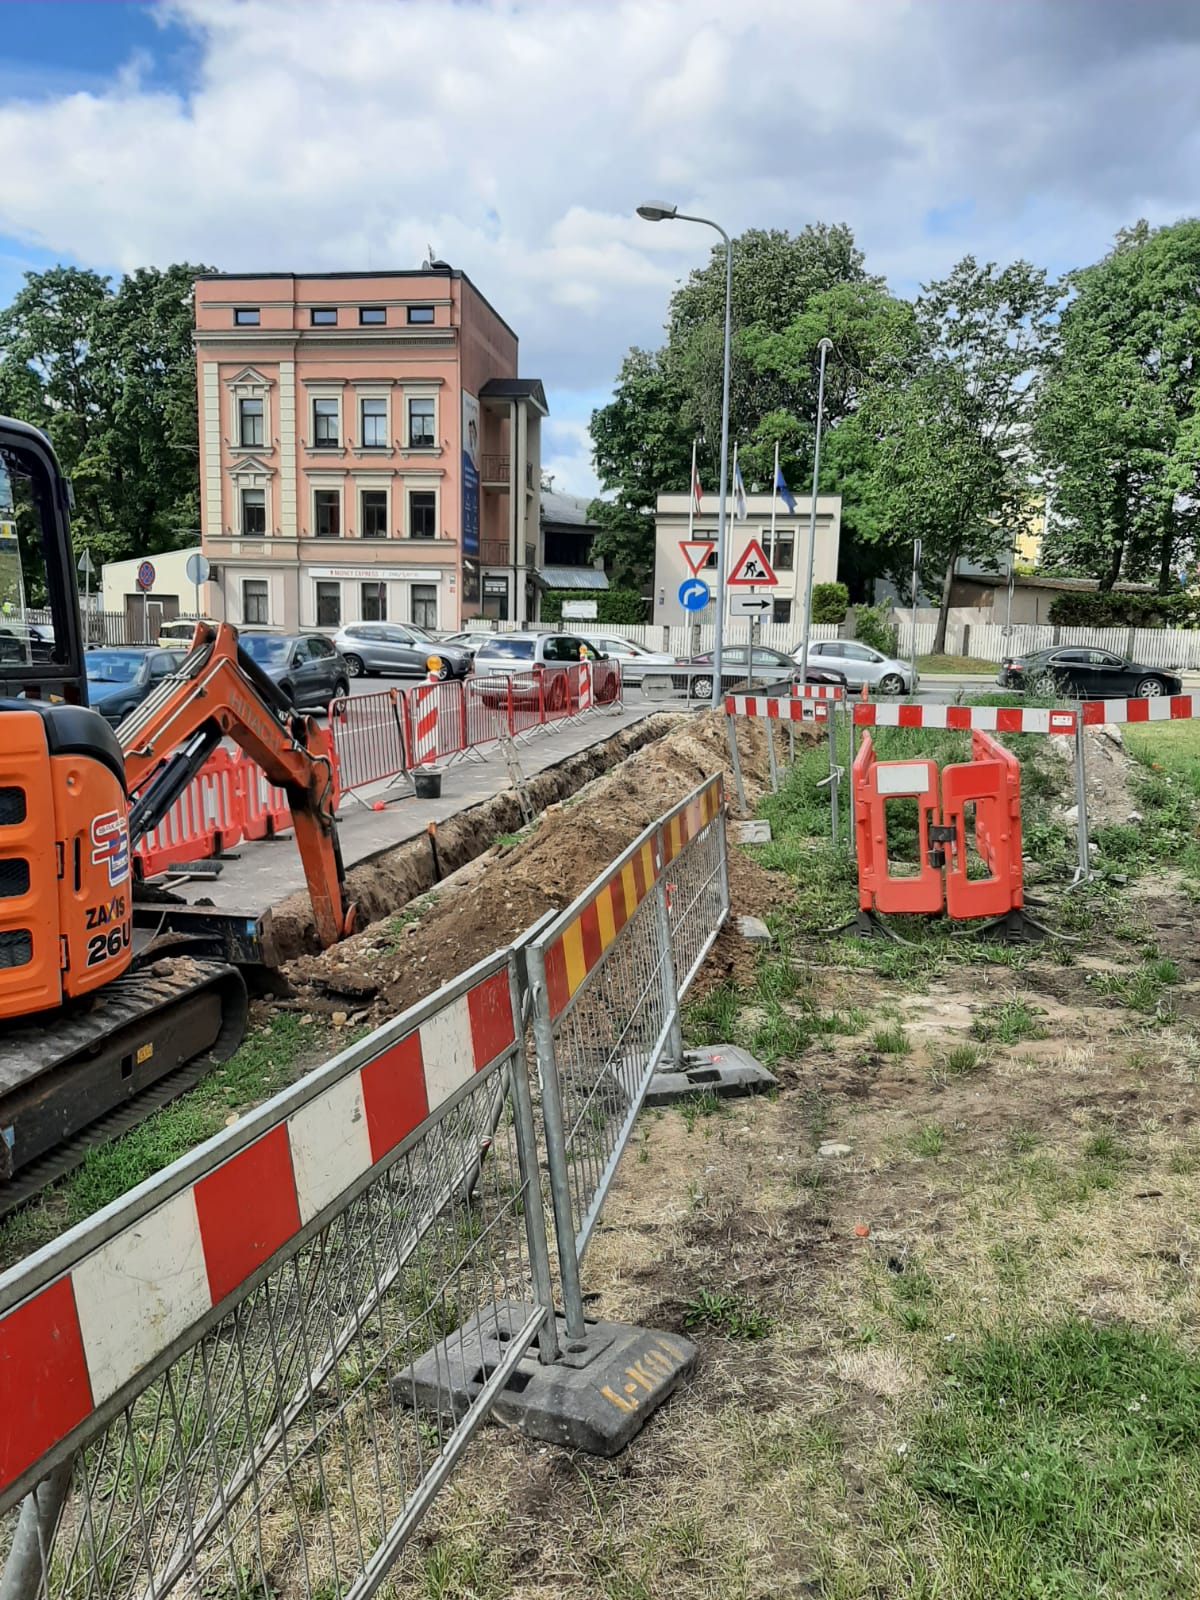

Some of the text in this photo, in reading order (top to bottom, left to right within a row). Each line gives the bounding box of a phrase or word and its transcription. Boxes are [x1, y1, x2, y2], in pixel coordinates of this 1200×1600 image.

[334, 569, 353, 577] MONEY
[354, 570, 380, 578] EXPRESS
[85, 896, 125, 930] ZAXIS
[86, 918, 131, 967] 26U
